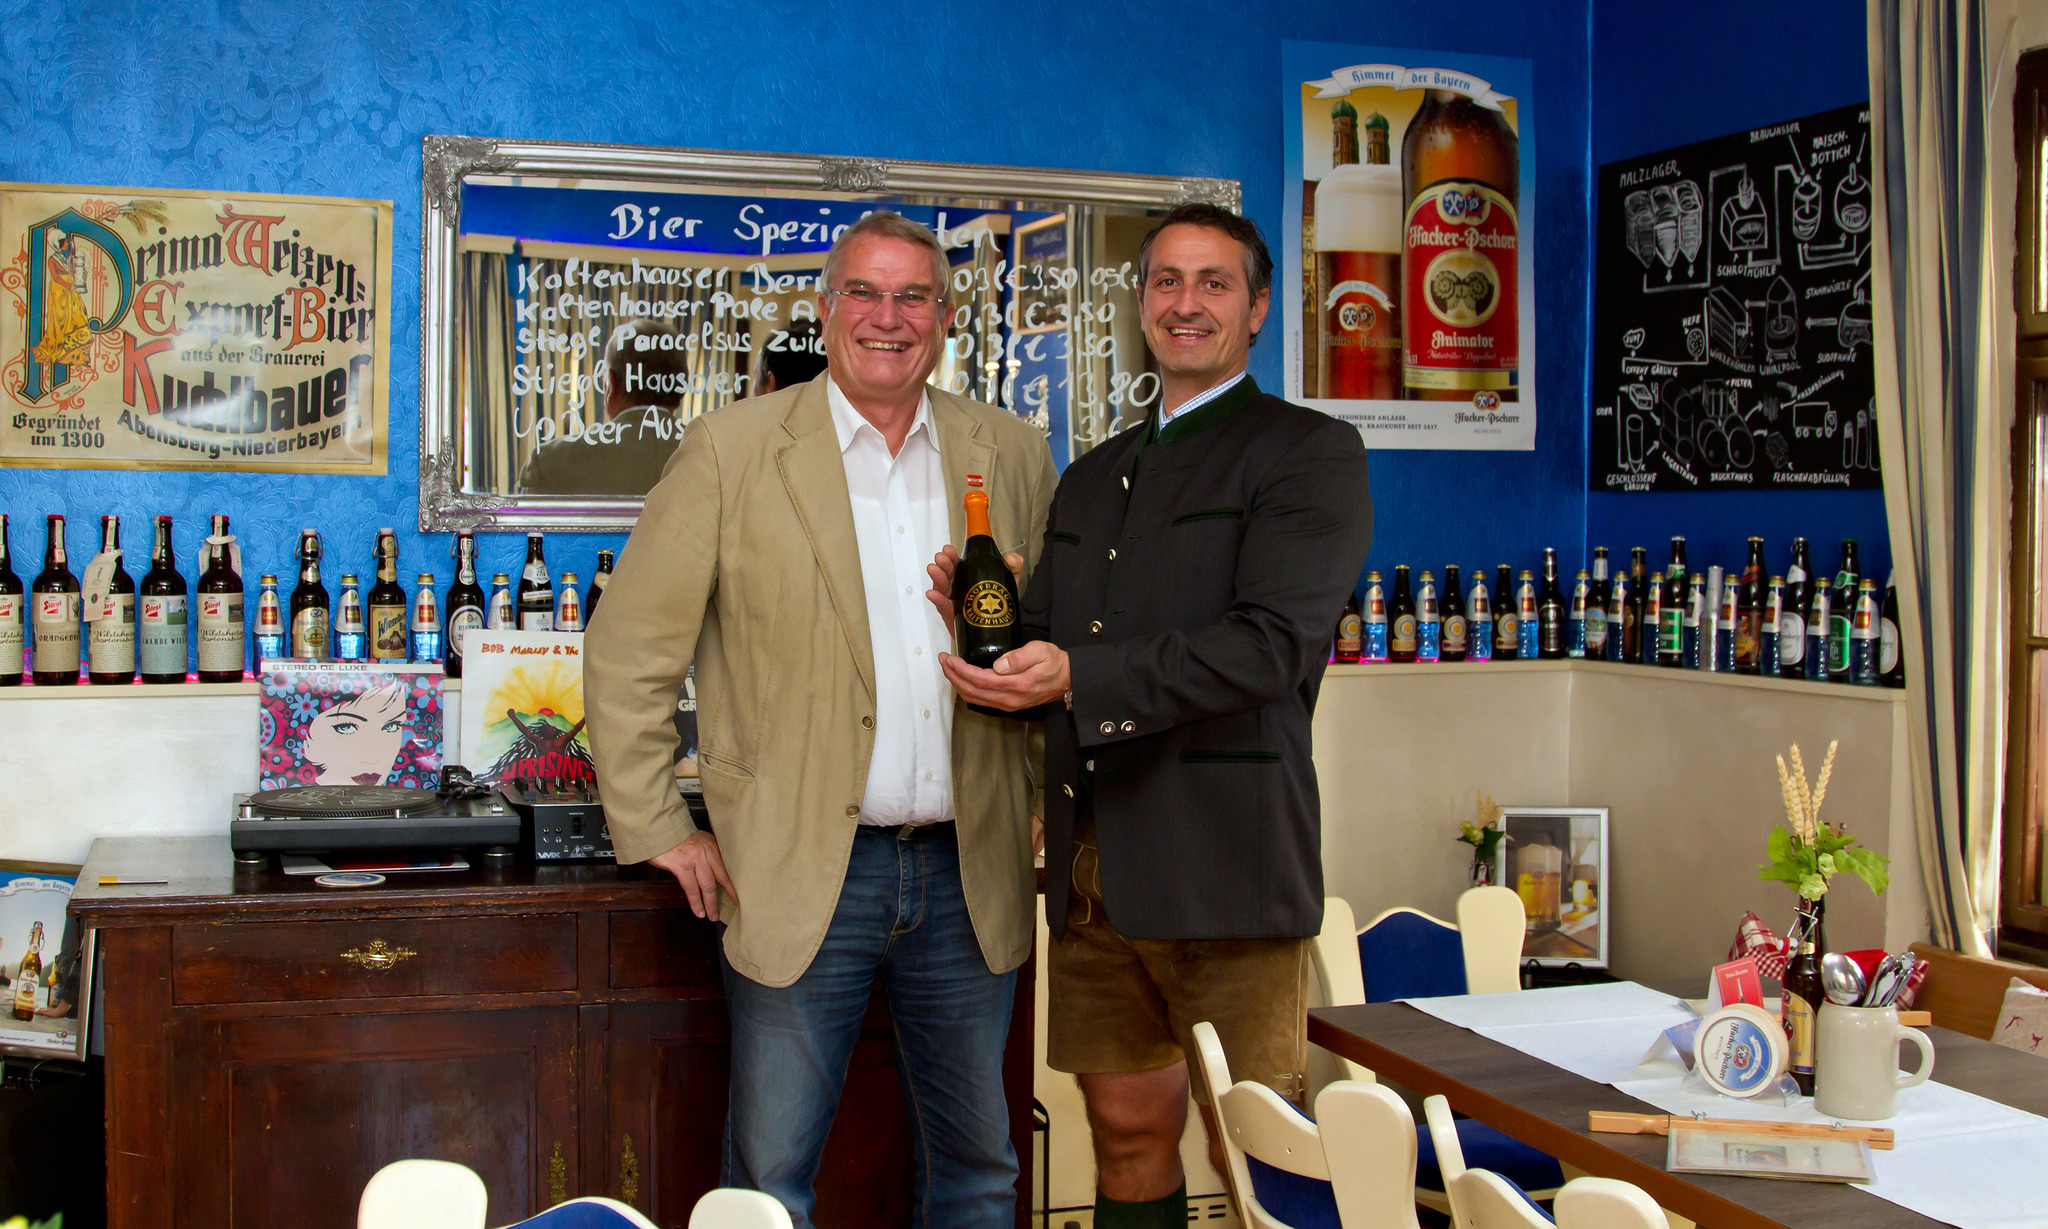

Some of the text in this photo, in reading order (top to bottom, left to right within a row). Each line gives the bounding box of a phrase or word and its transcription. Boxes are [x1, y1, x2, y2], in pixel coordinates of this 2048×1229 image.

[1352, 71, 1471, 91] Himmel der Bayern
[1810, 145, 1852, 167] BOTTICH
[1619, 160, 1679, 188] MALZLAGER
[607, 203, 703, 241] Bier
[1409, 225, 1516, 251] Hacker-Pschorr
[517, 257, 730, 294] Kaltenhauser
[1031, 264, 1079, 297] 3,50
[516, 291, 704, 323] Kaltenhauser
[709, 291, 779, 320] Pale
[953, 300, 1019, 332] 0,3l
[1025, 301, 1046, 329] €
[1055, 301, 1116, 332] 3,50
[516, 326, 601, 360] Stiegl
[613, 321, 753, 352] Paracelsus
[953, 332, 1023, 368] 0,3l
[1024, 334, 1047, 361] €
[1056, 333, 1117, 366] 3,50
[1431, 330, 1494, 349] Animator
[181, 344, 326, 367] aus der Brauerei
[512, 359, 607, 408] Stiegl
[625, 361, 751, 394] Hausbier
[12, 413, 101, 433] Begründet
[561, 410, 632, 445] Beer
[1455, 412, 1520, 425] Hacker-Pschorr
[31, 432, 105, 449] um 1300
[43, 600, 62, 611] Stiegl
[145, 603, 161, 614] Stiegl
[204, 601, 221, 612] Stiegl
[481, 643, 505, 654] BOB
[510, 645, 550, 656] MARLEY
[552, 645, 562, 655] &
[500, 751, 597, 784] UPRISING
